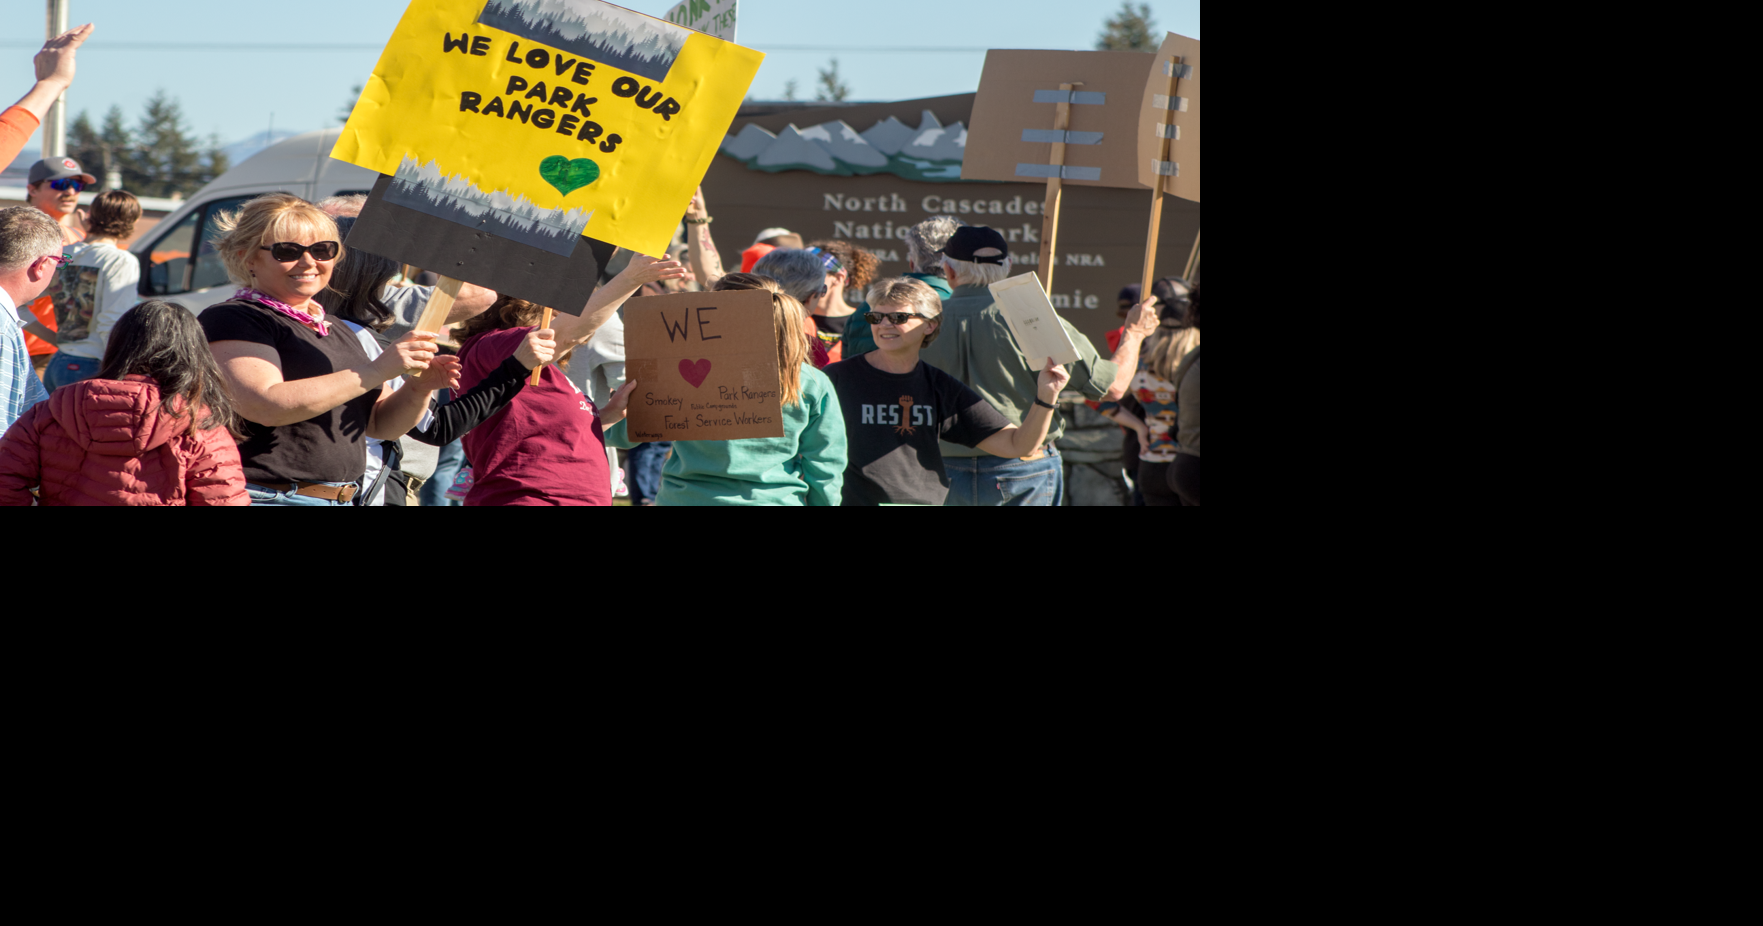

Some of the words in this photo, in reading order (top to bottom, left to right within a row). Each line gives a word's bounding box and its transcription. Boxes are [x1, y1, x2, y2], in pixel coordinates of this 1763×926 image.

[443, 32, 492, 56] WE
[506, 41, 596, 85] LOVE
[611, 76, 681, 121] OUR
[505, 75, 598, 118] PARK
[459, 91, 623, 153] RANGERS
[823, 193, 907, 212] North
[833, 220, 911, 239] Natio
[1065, 253, 1105, 267] NRA
[660, 307, 722, 343] WE
[645, 392, 684, 411] Smokey
[717, 385, 739, 401] Park
[741, 386, 776, 403] Rangers
[664, 415, 690, 430] Forest
[696, 414, 732, 428] Service
[733, 412, 772, 425] Workers
[861, 396, 933, 433] RESIST
